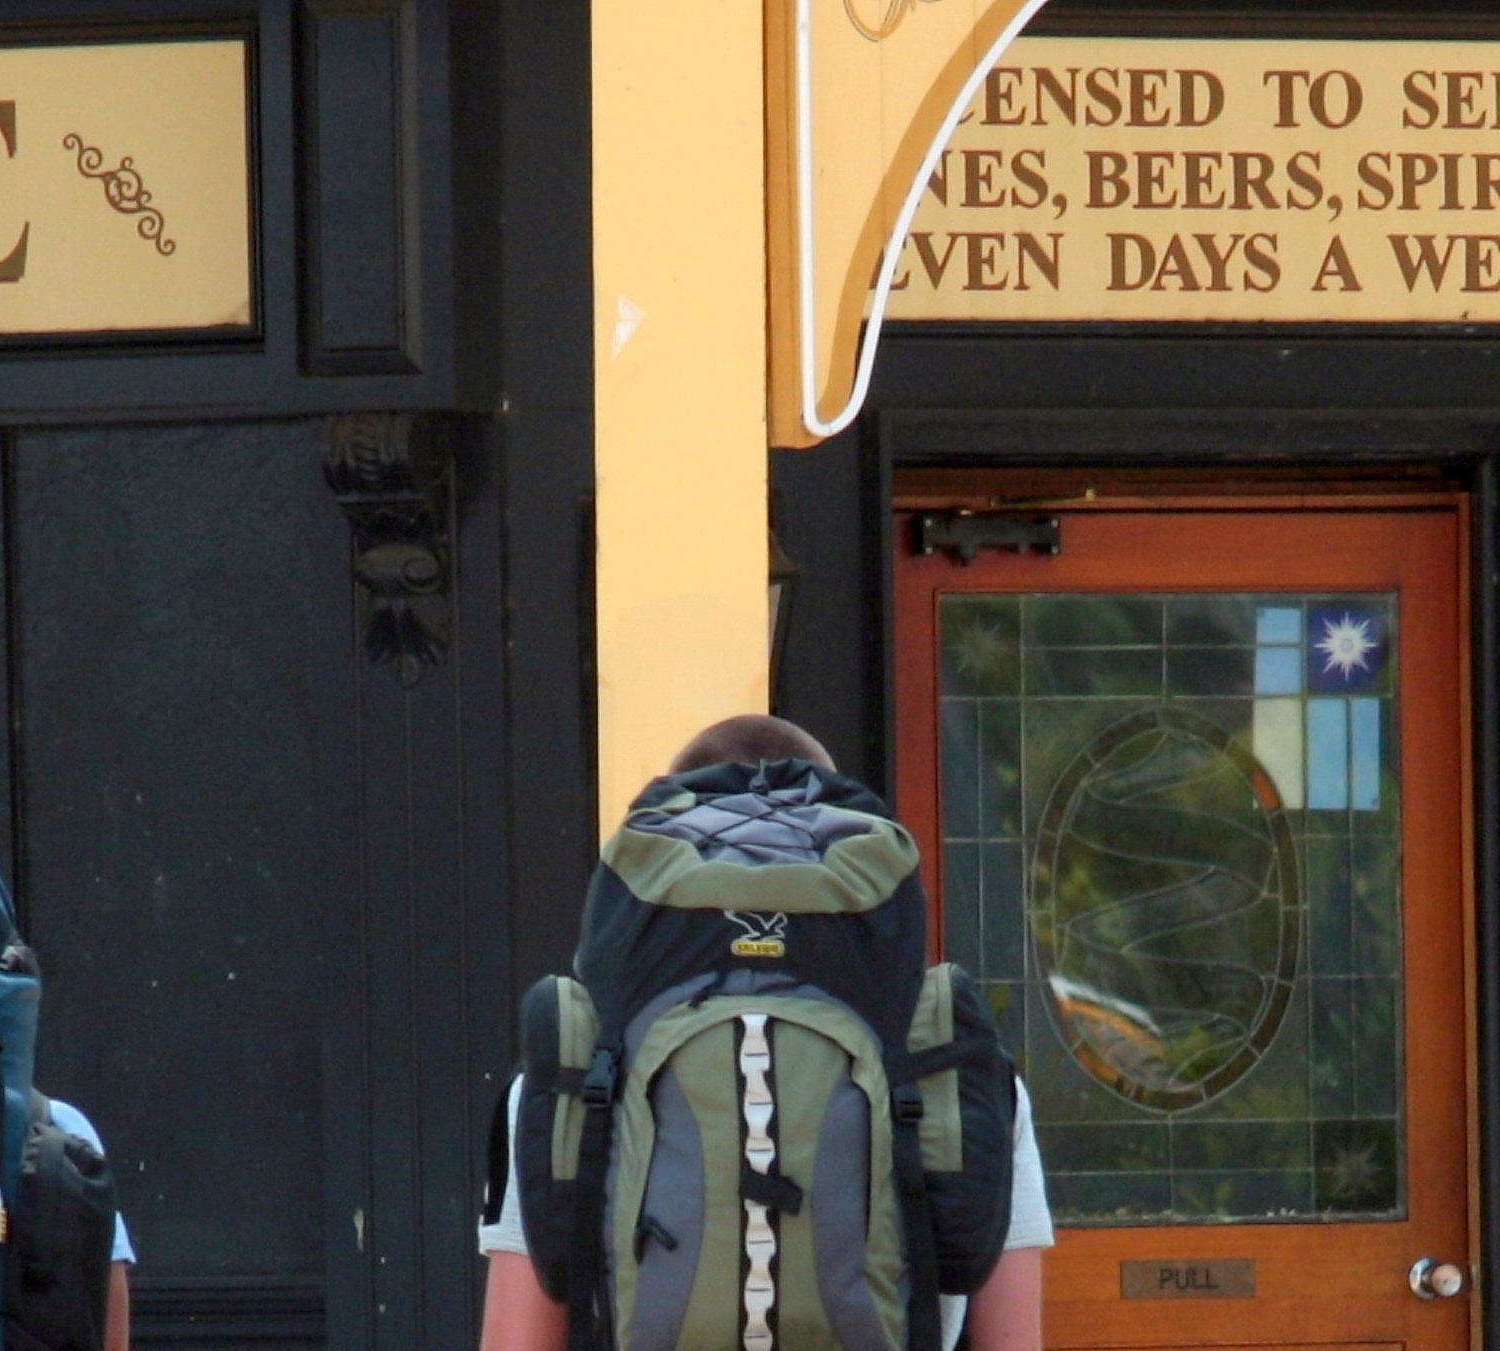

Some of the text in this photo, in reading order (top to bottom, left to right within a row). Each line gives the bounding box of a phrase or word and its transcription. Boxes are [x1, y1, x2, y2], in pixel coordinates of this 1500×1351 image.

[957, 66, 1225, 128] ENSED
[1263, 70, 1363, 129] TO
[1084, 150, 1344, 223] BEERS,
[1105, 232, 1281, 293] DAYS
[1311, 233, 1363, 292] A
[1159, 1267, 1219, 1290] PULL
